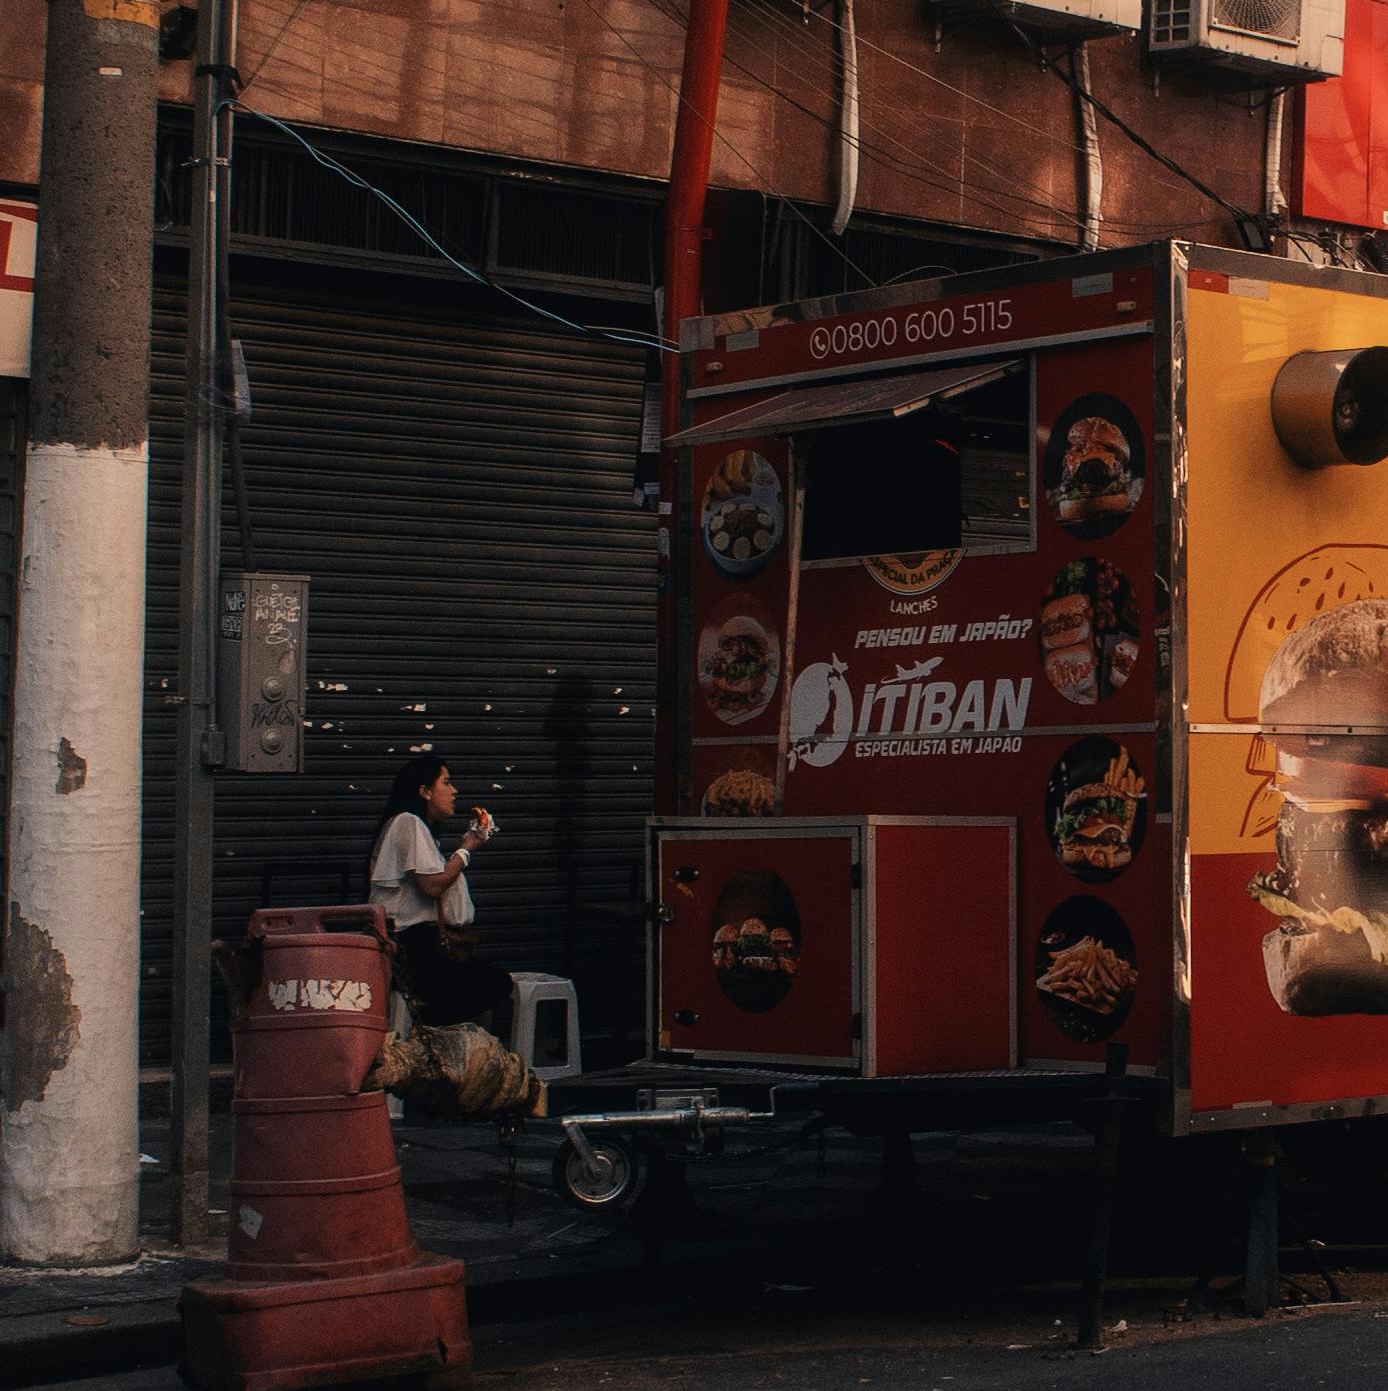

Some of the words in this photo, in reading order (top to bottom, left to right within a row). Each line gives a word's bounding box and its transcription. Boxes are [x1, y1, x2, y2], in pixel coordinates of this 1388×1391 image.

[832, 318, 898, 354] 0800
[905, 308, 955, 342] 600
[962, 299, 1013, 335] 5115
[889, 595, 939, 616] LANCHES
[855, 626, 927, 649] PENSOU
[928, 623, 958, 644] EM
[960, 614, 1033, 642] JAPÃO?
[855, 739, 948, 758] ESPECIALISTA
[951, 738, 975, 755] EM
